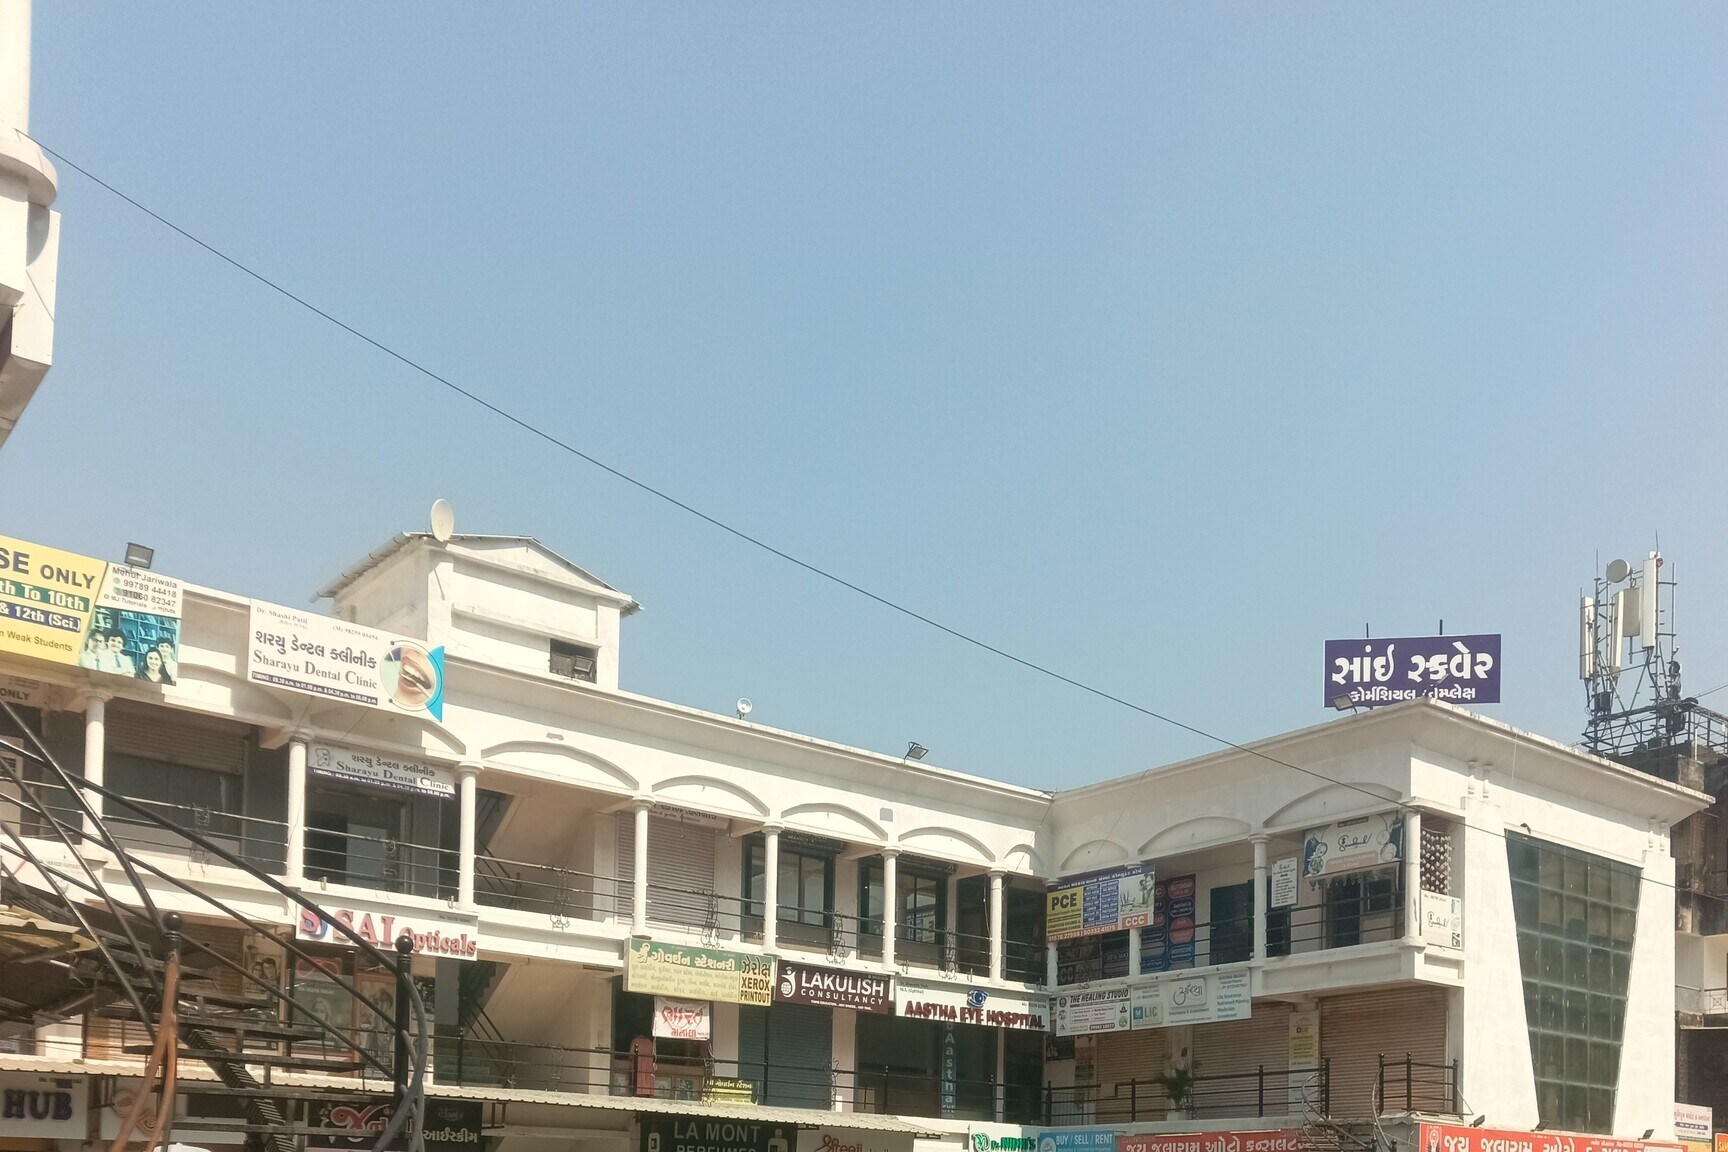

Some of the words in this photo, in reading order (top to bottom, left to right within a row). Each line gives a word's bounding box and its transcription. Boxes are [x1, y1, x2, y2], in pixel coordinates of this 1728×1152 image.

[41, 564, 96, 590] ONLY
[142, 574, 178, 589] Jariwala
[20, 584, 42, 601] To
[48, 590, 85, 612] 10th
[15, 606, 45, 625] 12th
[8, 630, 32, 645] Weak
[35, 637, 74, 653] Students
[255, 630, 286, 655] શરયુ
[291, 633, 325, 657] ડેન્ટલ
[253, 649, 300, 673] Sharayu
[304, 660, 342, 682] Dental
[344, 670, 378, 690] Clinic
[336, 761, 379, 777] Sharayu
[384, 770, 416, 785] Dental
[420, 777, 450, 790] Clinic
[1051, 893, 1077, 910] PCE
[1125, 915, 1145, 927] CCC
[650, 948, 691, 967] ગોવર્ધન
[694, 954, 736, 972] સ્ટેશનરી
[741, 976, 771, 992] XEROX
[801, 970, 884, 997] LAKULISH
[740, 989, 770, 1004] PRINTOUT
[800, 988, 883, 1005] CONSULTANCY
[1071, 995, 1081, 1004] THE
[1107, 989, 1129, 999] STUDIO
[905, 1000, 958, 1022] AASTHA
[960, 1006, 984, 1025] EYE
[986, 1009, 1046, 1030] HOSPITAL
[1144, 1006, 1158, 1018] LIC
[4, 1089, 73, 1120] HUB
[674, 1121, 700, 1140] LA
[705, 1123, 761, 1143] MONT
[1056, 1135, 1069, 1146] BUY
[1074, 1134, 1089, 1145] SELL
[1095, 1134, 1113, 1145] RENT
